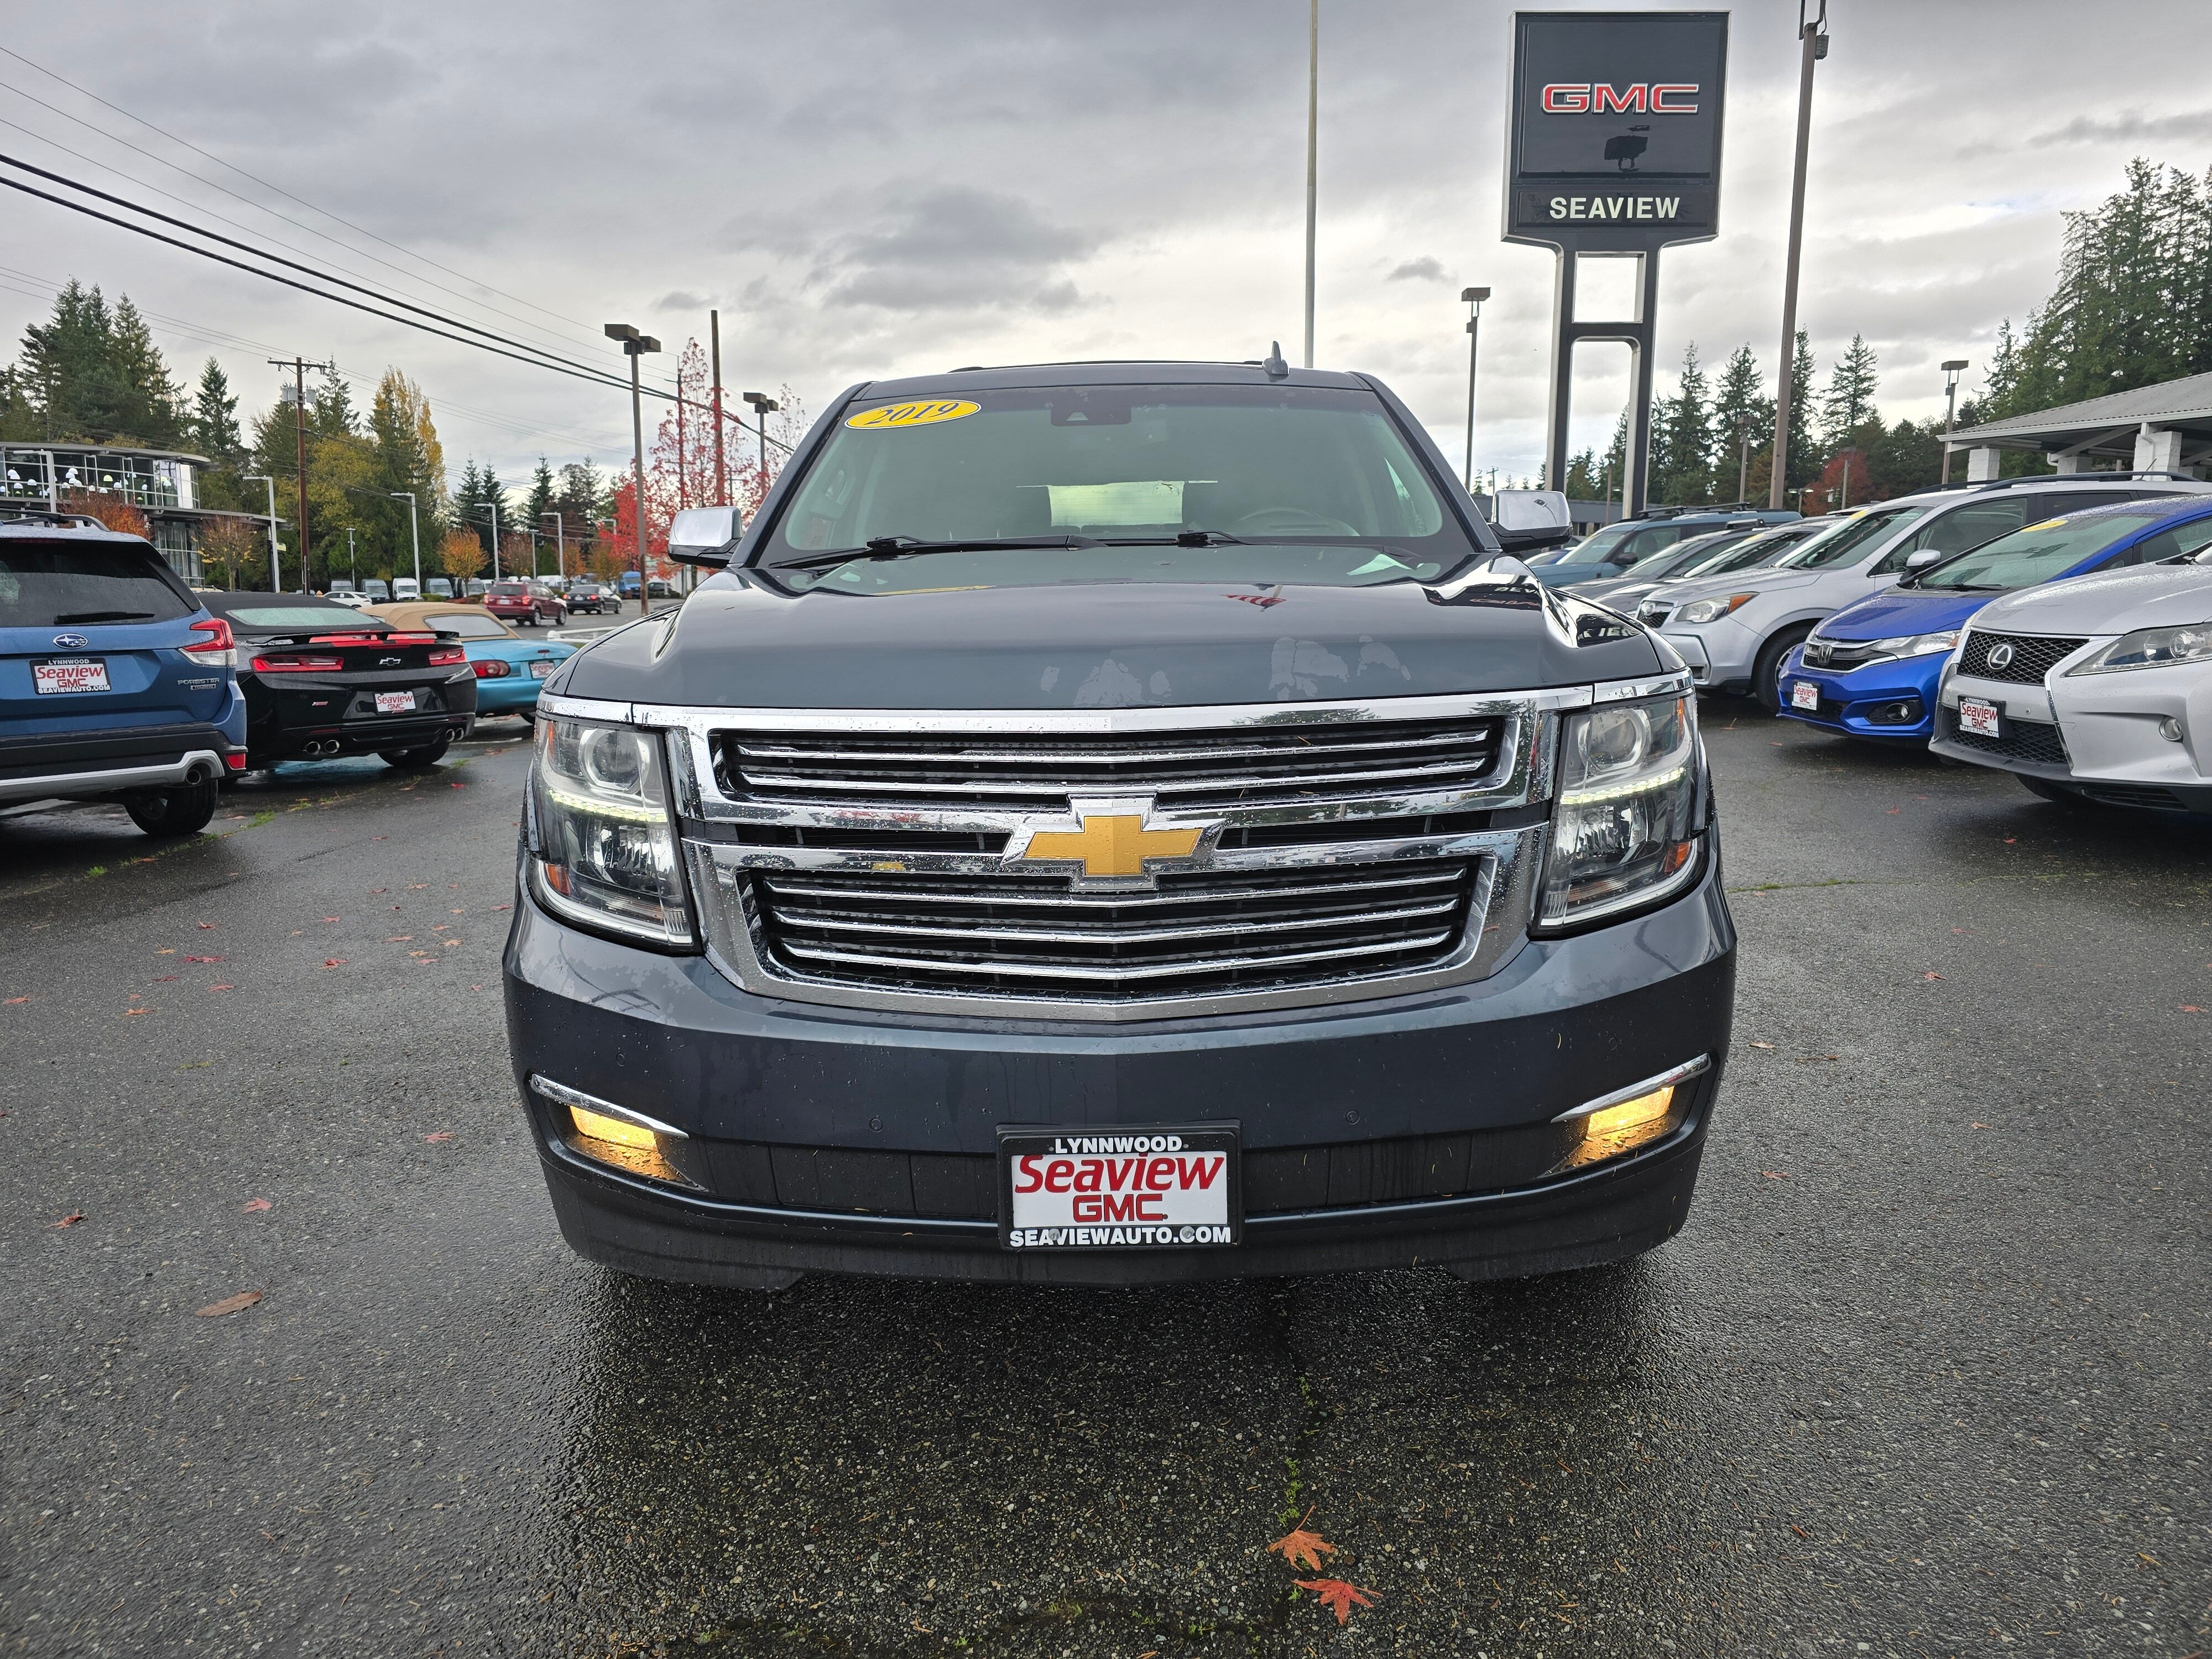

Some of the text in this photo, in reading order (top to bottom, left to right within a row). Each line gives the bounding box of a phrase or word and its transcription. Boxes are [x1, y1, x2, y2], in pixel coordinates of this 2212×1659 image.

[1542, 83, 1699, 114] GMC
[1550, 197, 1680, 219] SEAVIEW
[863, 402, 959, 426] 2019
[36, 665, 103, 680] Seaview
[38, 685, 111, 694] SEAVIEWAUTO.COM
[56, 678, 88, 688] GMC
[377, 695, 414, 705] Seaview
[1961, 702, 1998, 721] Seaview
[1971, 717, 1988, 729] GMC
[1055, 1136, 1183, 1154] LYNNWOOD
[1015, 1152, 1225, 1193] Seaview
[1072, 1193, 1164, 1223] GMC
